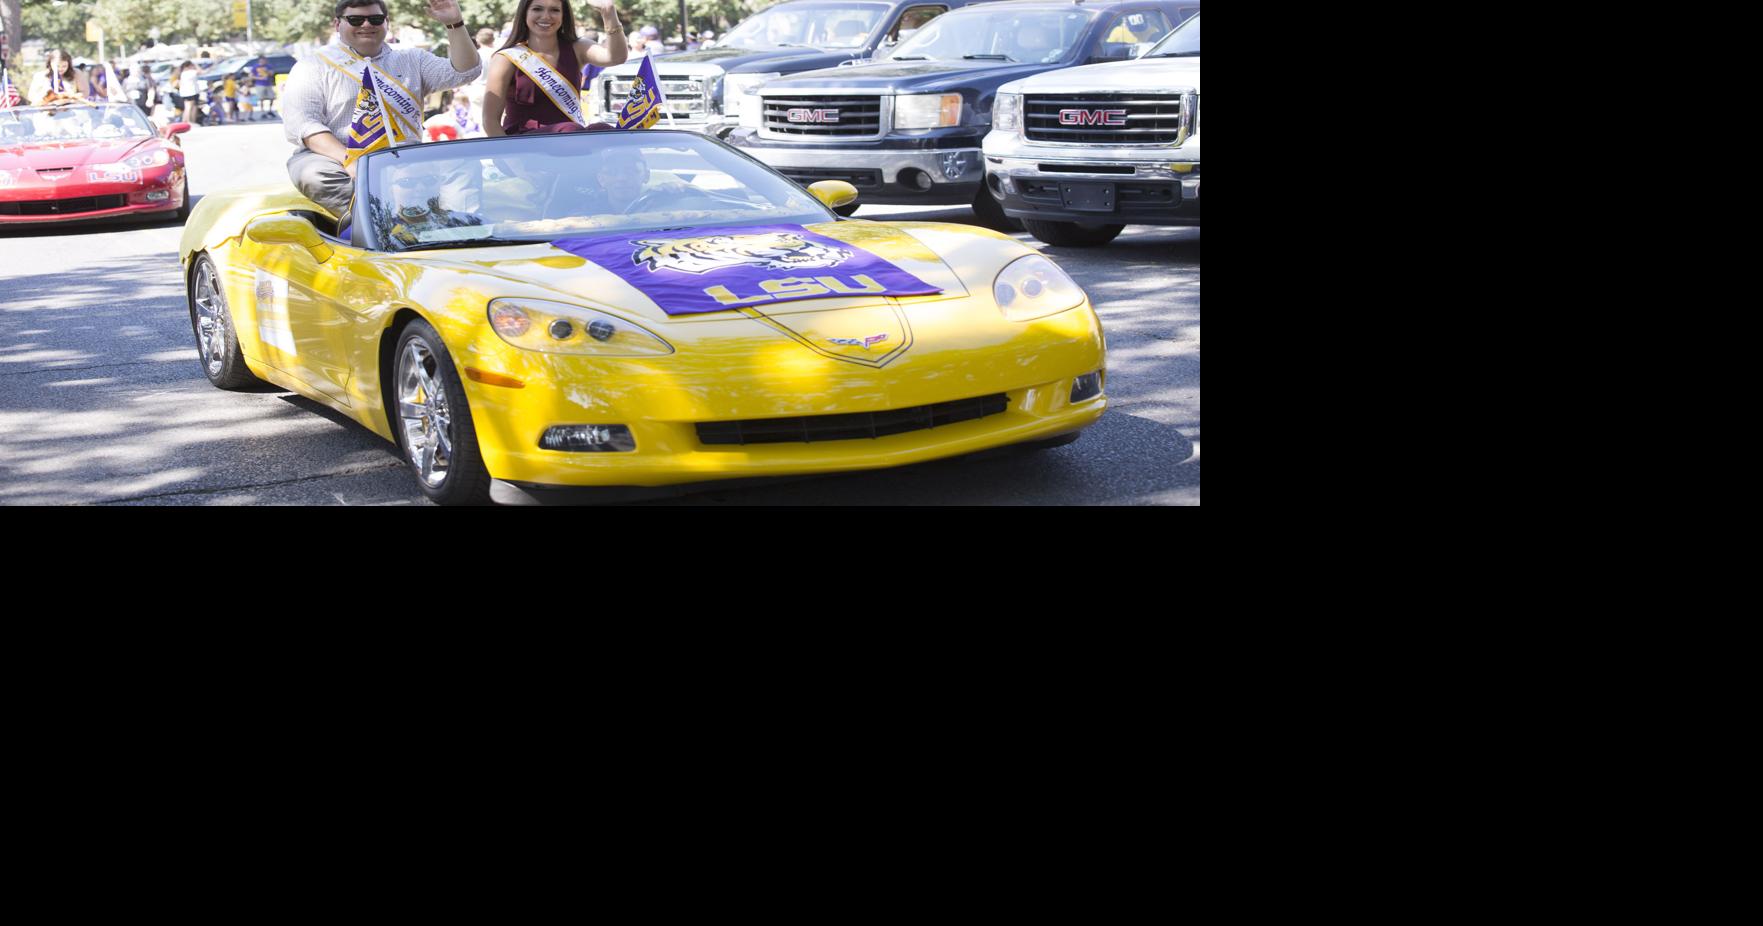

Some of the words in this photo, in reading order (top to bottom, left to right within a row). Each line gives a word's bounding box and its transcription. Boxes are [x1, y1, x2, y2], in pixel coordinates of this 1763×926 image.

[373, 71, 416, 115] mecoming
[535, 67, 578, 115] Homecoming
[618, 87, 656, 128] LSU
[787, 108, 839, 123] GMC
[1059, 109, 1126, 125] GMC
[703, 274, 887, 305] LSU
